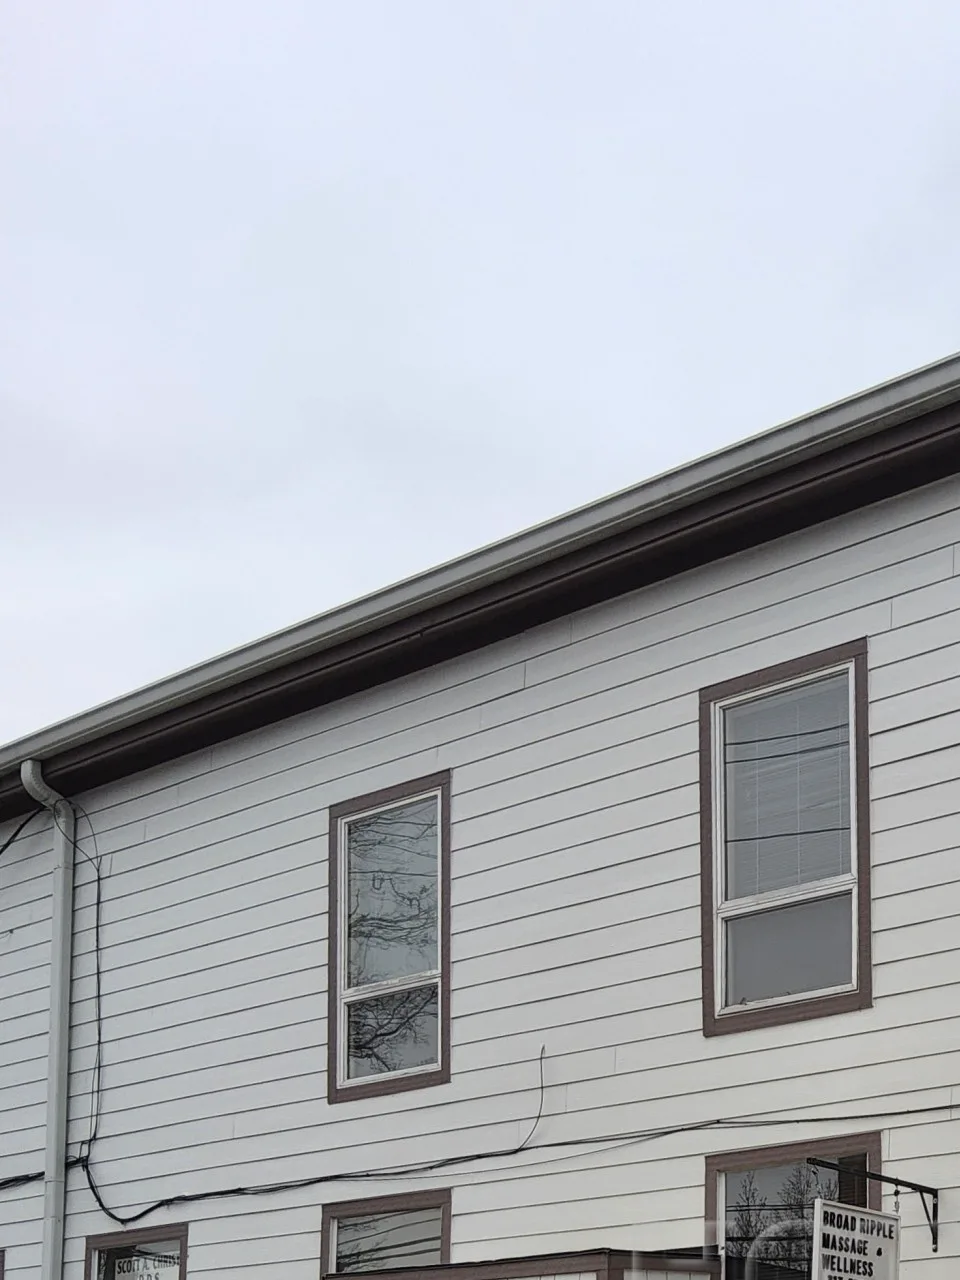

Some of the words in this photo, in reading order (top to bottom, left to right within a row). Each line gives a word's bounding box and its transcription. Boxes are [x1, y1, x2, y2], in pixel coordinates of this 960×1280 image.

[823, 1211, 857, 1231] BROAD
[860, 1217, 894, 1239] RIPPLE
[822, 1232, 868, 1256] MASSAGE
[117, 1259, 140, 1274] SCOTT
[822, 1253, 873, 1277] WELLNESS
